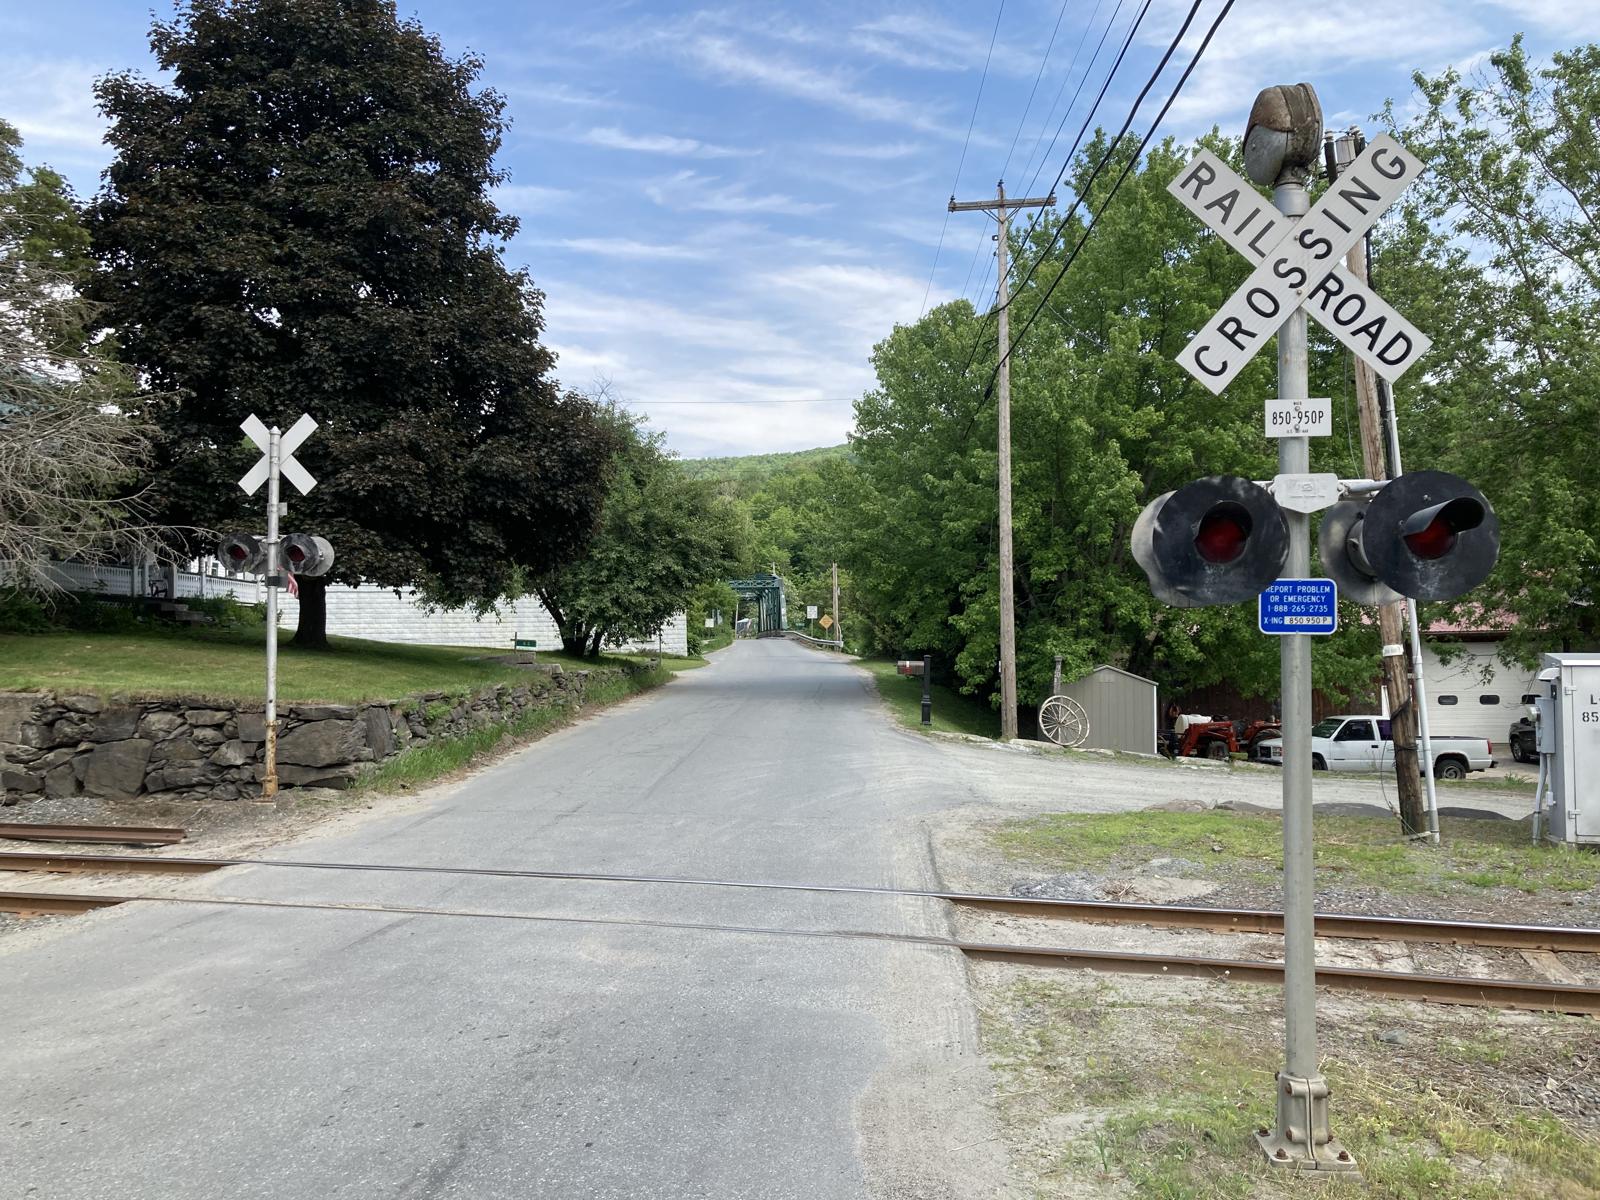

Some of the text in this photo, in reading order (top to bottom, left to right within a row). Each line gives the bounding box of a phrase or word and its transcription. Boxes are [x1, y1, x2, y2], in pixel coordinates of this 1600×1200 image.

[1180, 160, 1413, 366] RAIL ROAD
[1194, 148, 1406, 377] CROSSING
[1272, 410, 1324, 425] 850-950P
